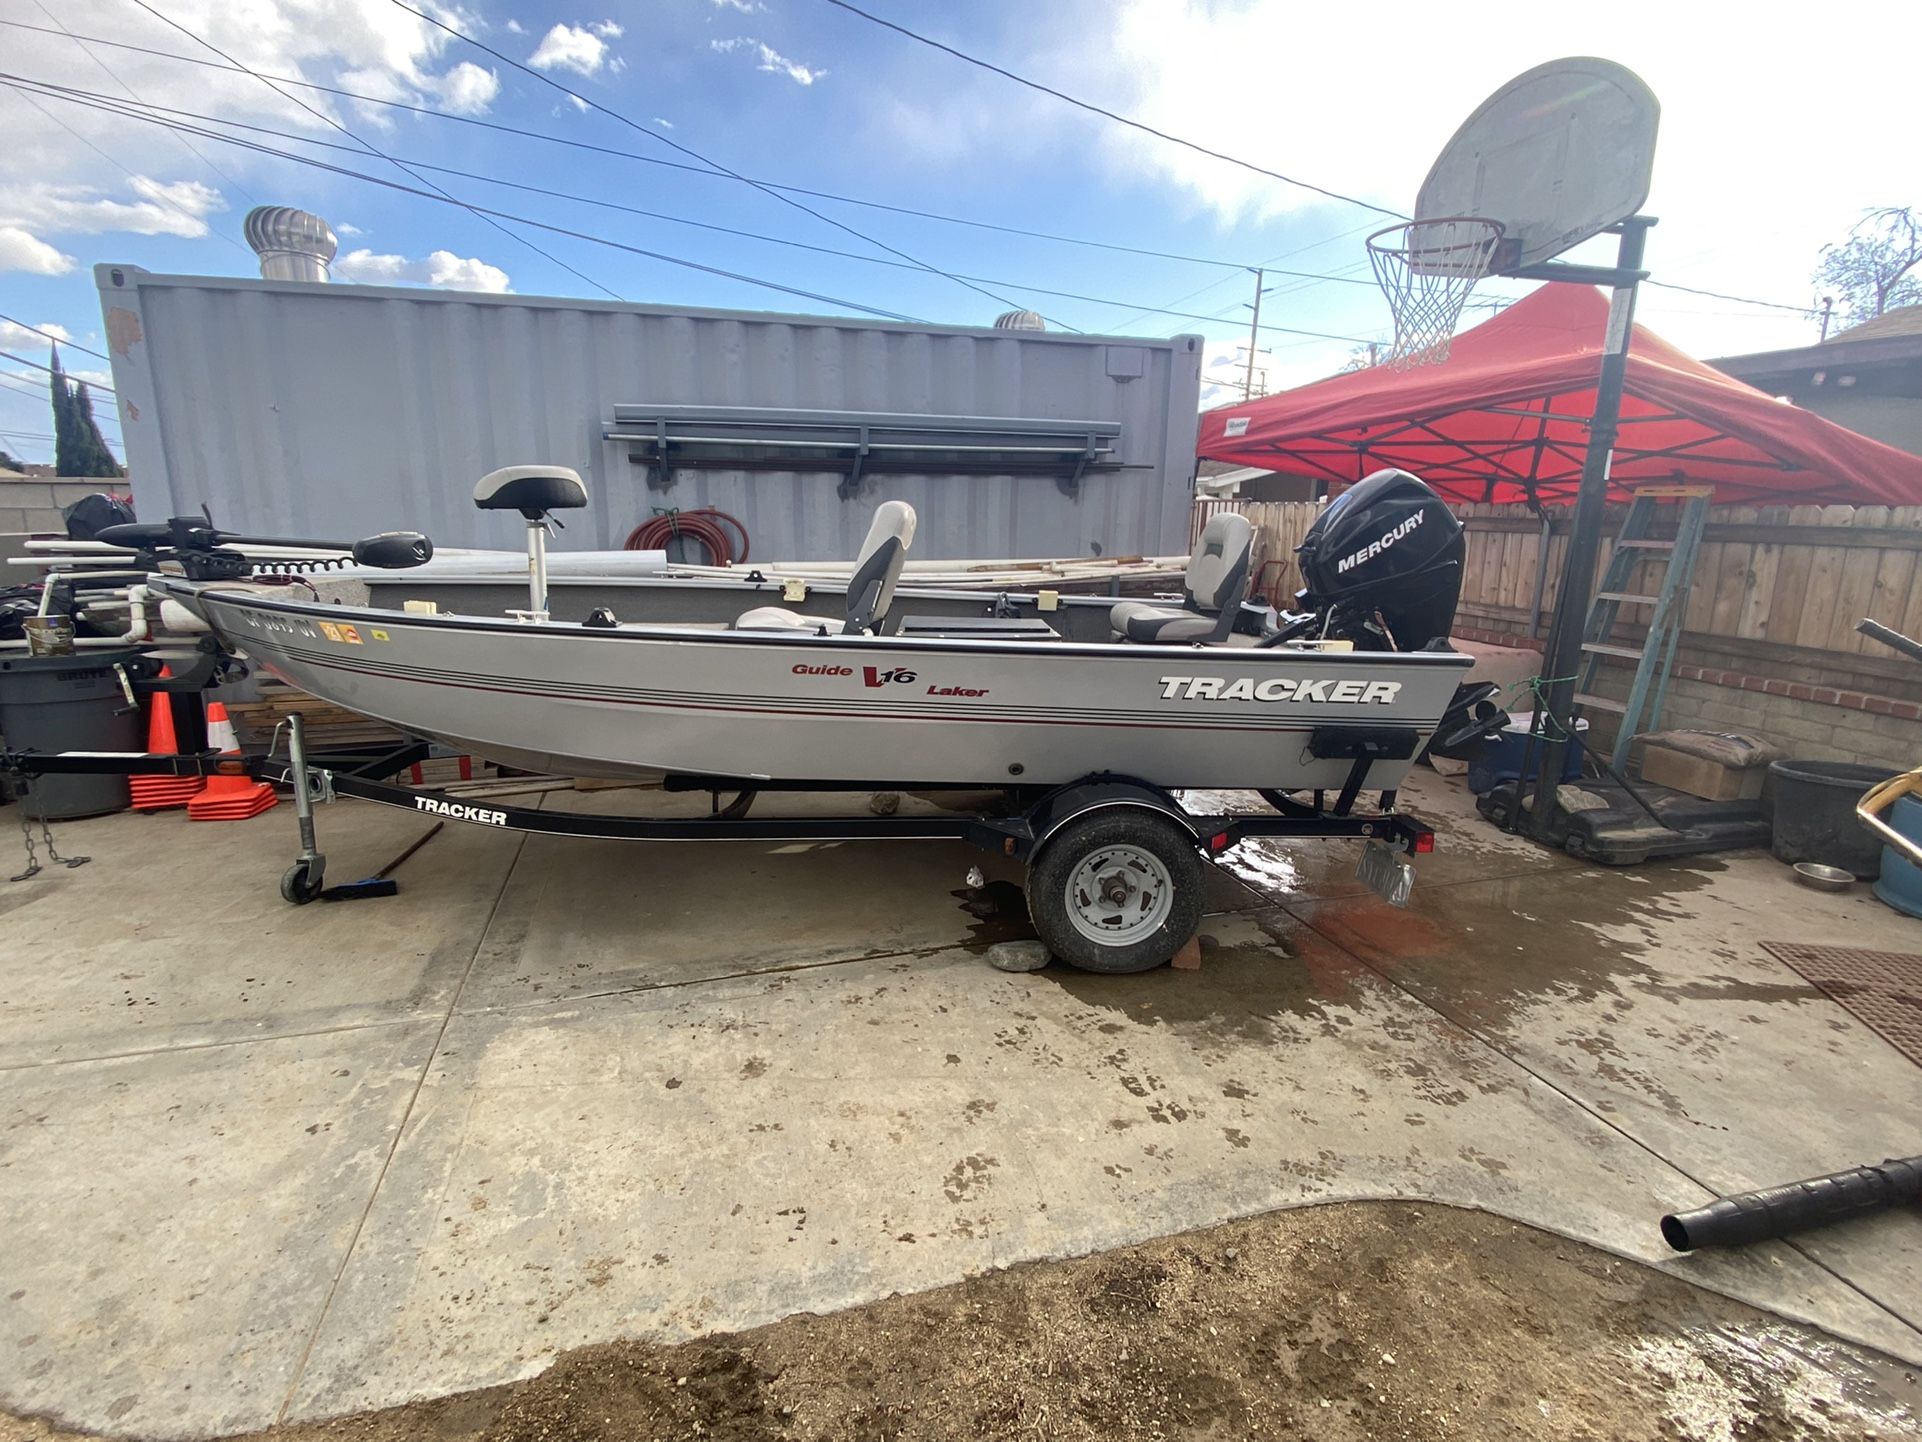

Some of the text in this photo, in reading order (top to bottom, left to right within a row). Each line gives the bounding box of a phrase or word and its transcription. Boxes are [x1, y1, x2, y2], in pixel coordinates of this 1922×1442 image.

[1338, 509, 1424, 574] MERCURY
[791, 664, 853, 676] Guide
[926, 685, 989, 697] Laker
[1159, 676, 1402, 704] TRACKER
[415, 796, 508, 826] TRACKER
